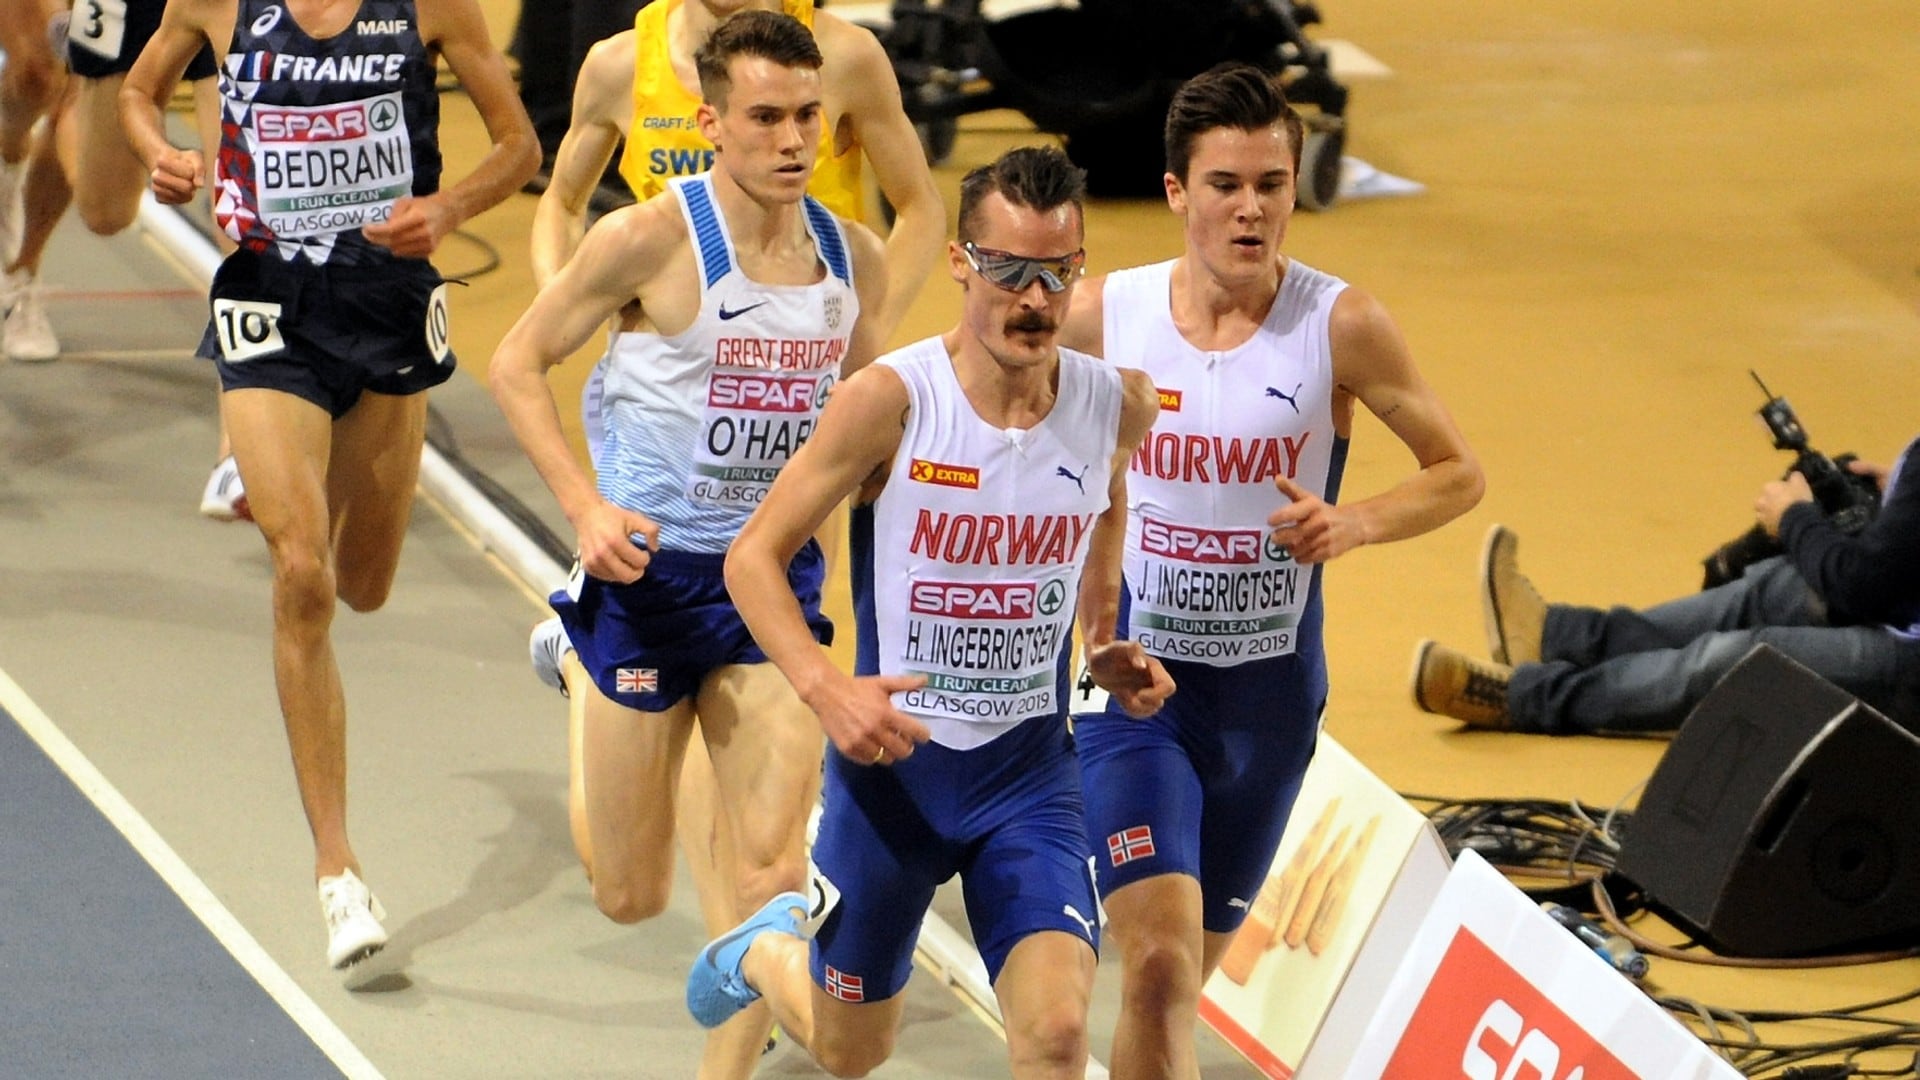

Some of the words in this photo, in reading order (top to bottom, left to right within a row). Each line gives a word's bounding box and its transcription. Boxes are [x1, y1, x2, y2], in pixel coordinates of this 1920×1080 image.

[83, 0, 104, 39] 3
[356, 20, 408, 36] MAIF
[272, 53, 406, 82] FRANCE
[258, 109, 365, 140] SPAR
[643, 117, 684, 129] CRAFT
[263, 136, 406, 189] BEDRANI
[289, 199, 294, 210] I
[297, 194, 331, 210] RUN
[332, 189, 380, 206] CLEAN
[268, 207, 366, 233] GLASGOW
[370, 204, 393, 222] 20
[220, 306, 272, 351] 10
[715, 337, 777, 369] GREAT
[779, 338, 848, 370] BRITAIN
[711, 375, 816, 409] SPAR
[707, 415, 819, 461] O'HAR
[1131, 431, 1311, 484] NORWAY
[730, 468, 760, 480] RUN
[935, 469, 977, 485] EXTRA
[694, 481, 769, 504] GLASGO
[909, 508, 1094, 566] NORWAY
[1143, 521, 1260, 561] SPAR
[912, 586, 1034, 616] SPAR
[1137, 560, 1151, 602] J.
[1156, 563, 1299, 614] INGEBRIGTSEN
[1164, 617, 1169, 629] I
[1172, 617, 1207, 632] RUN
[1209, 618, 1261, 634] CLEAN
[905, 620, 925, 662] H.
[929, 620, 1063, 671] INGEBRIGTSEN
[1138, 632, 1244, 657] GLASGOW
[1247, 632, 1290, 655] 2019
[934, 676, 940, 688] I
[943, 676, 979, 691] RUN
[980, 678, 1030, 693] CLEAN
[904, 689, 1014, 717] GLASGOW
[1016, 691, 1050, 715] 2019
